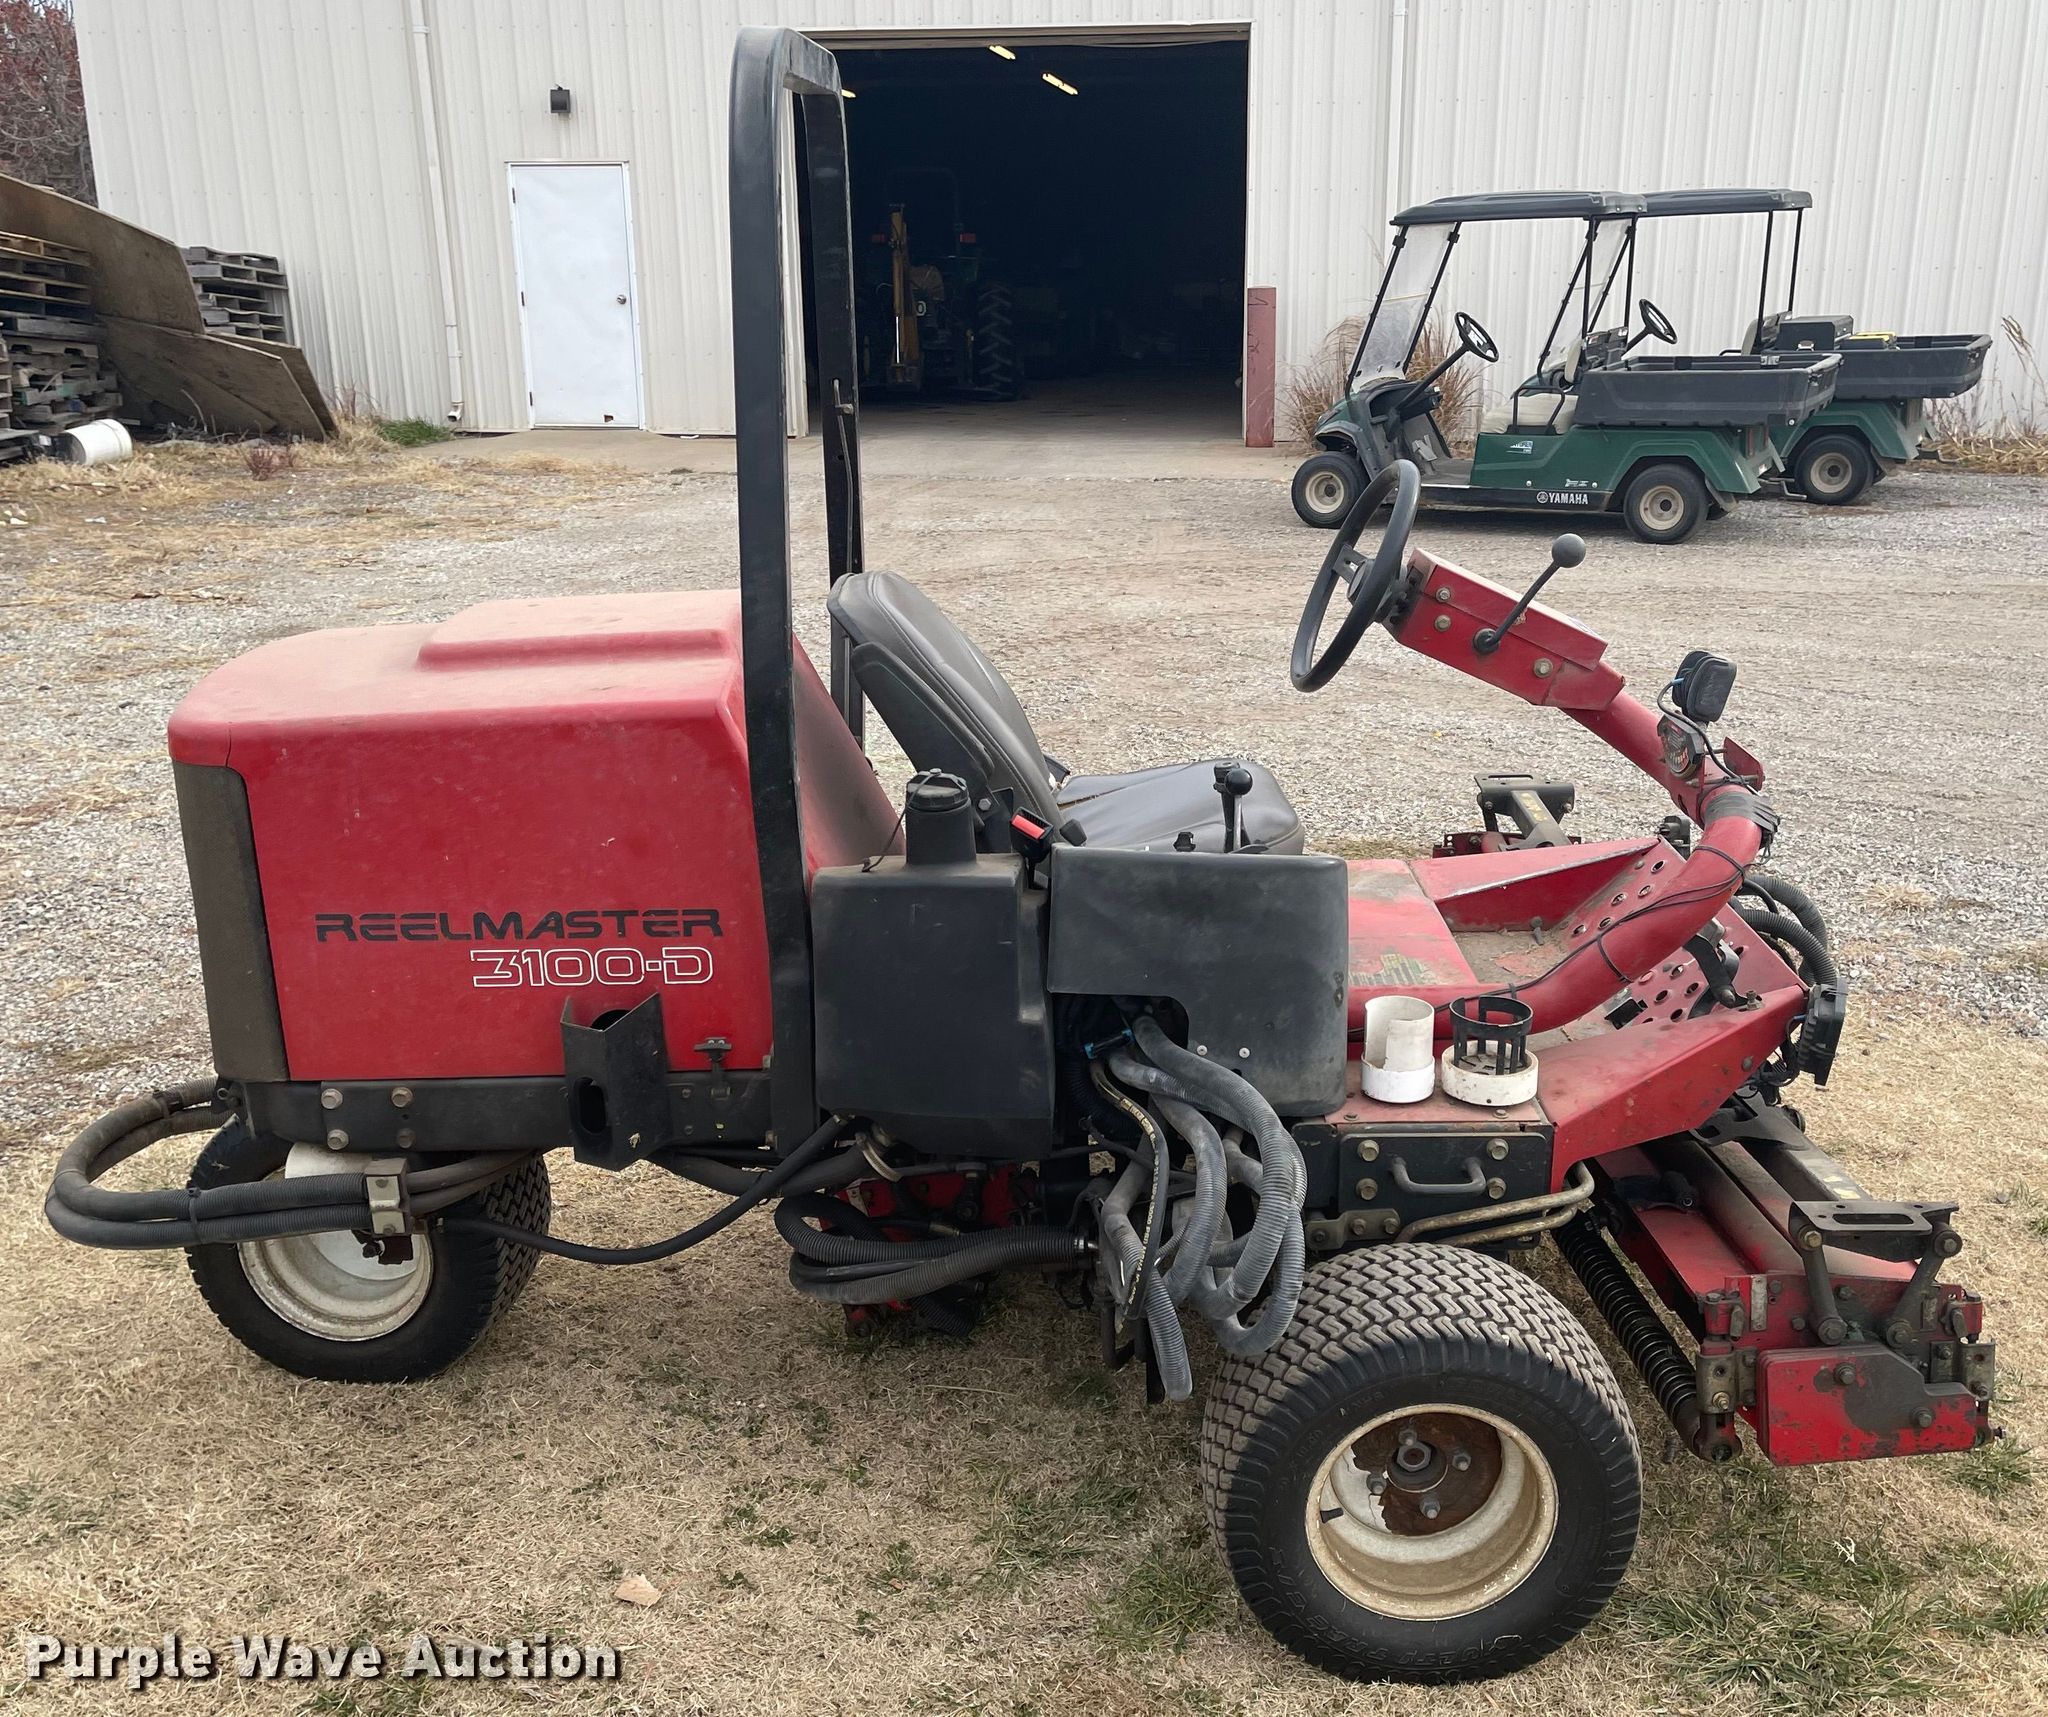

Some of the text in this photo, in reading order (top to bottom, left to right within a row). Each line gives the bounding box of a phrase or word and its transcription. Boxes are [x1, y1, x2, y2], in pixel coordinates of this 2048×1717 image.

[1549, 492, 1589, 505] YAMAHA
[316, 908, 723, 942] REELMASTER
[470, 946, 715, 987] 3100-D
